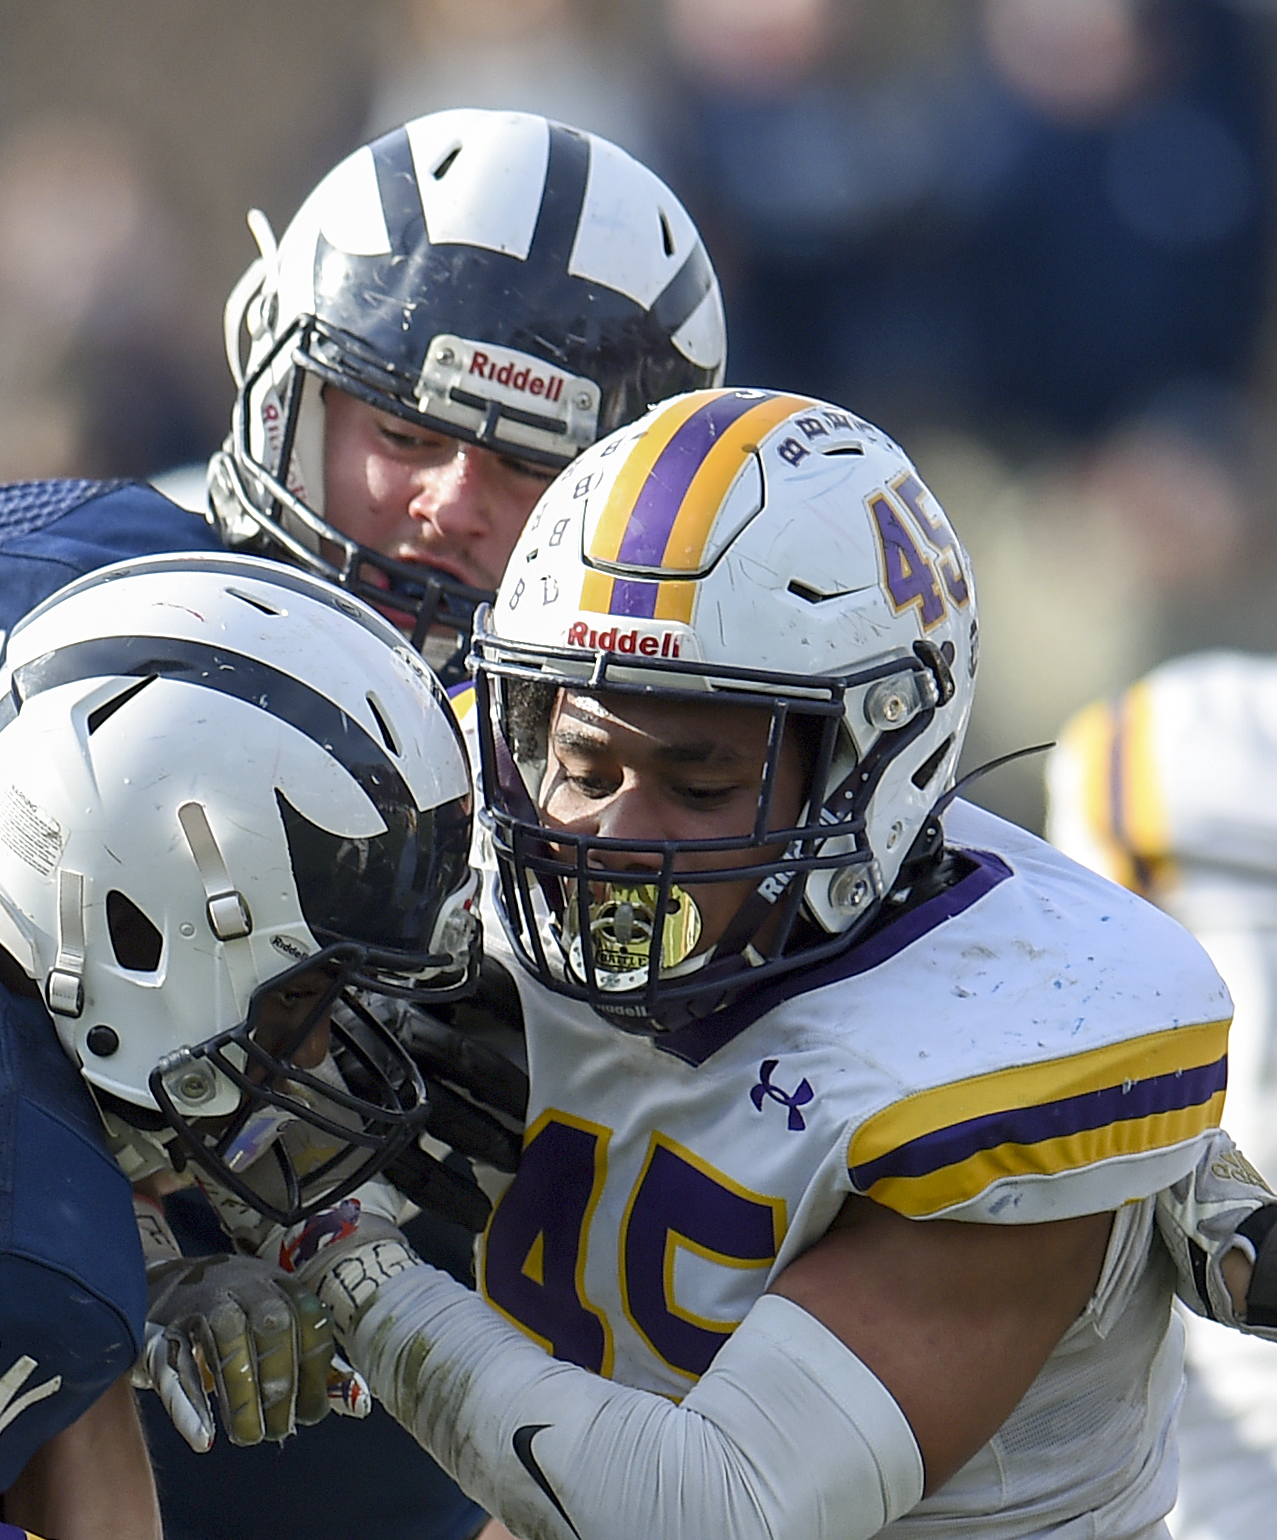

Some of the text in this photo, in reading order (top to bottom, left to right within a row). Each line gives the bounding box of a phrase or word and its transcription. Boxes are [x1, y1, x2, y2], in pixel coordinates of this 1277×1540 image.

[469, 351, 564, 402] Riddell
[795, 417, 830, 441] B
[777, 438, 811, 468] B
[866, 469, 970, 634] 45
[567, 621, 679, 658] Riddell
[482, 1107, 788, 1404] 45
